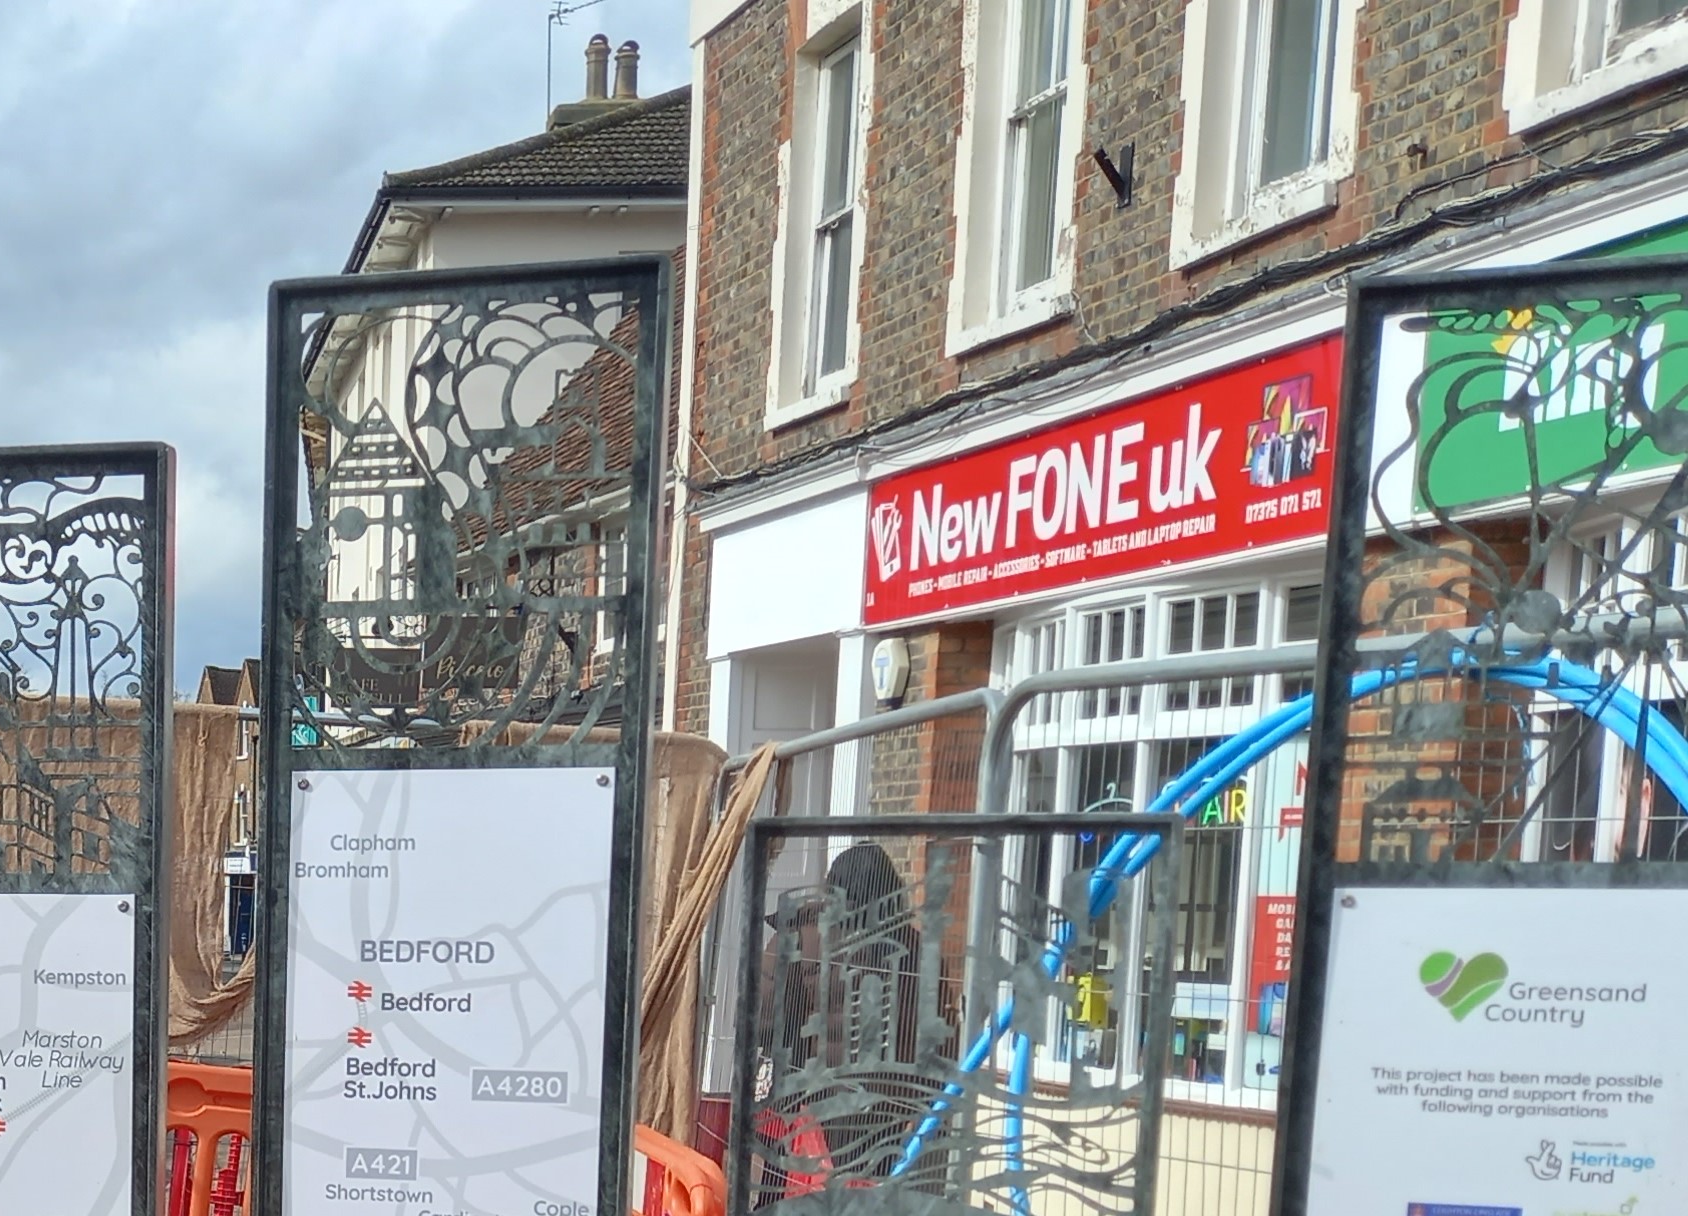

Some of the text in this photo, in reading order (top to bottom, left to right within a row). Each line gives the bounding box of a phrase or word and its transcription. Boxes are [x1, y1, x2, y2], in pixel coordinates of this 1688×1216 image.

[910, 403, 1222, 571] New FONE uk
[1245, 488, 1322, 524] 07375 071 571
[908, 514, 1216, 598] PHONES MOBILE REPAIR ACCESSORIES SOFTWARE TABLETS AND LAPTOP REPAIR
[330, 835, 415, 855] Clapham
[295, 862, 389, 879] Bromham
[360, 940, 495, 964] BEDFORD
[33, 970, 126, 987] Kempston
[1509, 982, 1647, 1002] Greensand
[381, 993, 471, 1012] Bedford
[1485, 1004, 1585, 1028] Country
[22, 1031, 102, 1048] Marston
[0, 1050, 124, 1072] Vale Railway
[346, 1058, 435, 1077] Bedford
[41, 1071, 83, 1088] Line
[477, 1076, 562, 1098] A4280
[1371, 1067, 1663, 1090] This project has been made possible
[351, 1154, 411, 1174] A421
[1570, 1151, 1655, 1172] Heritage
[1569, 1168, 1614, 1183] Fund
[325, 1184, 433, 1204] Shortstown
